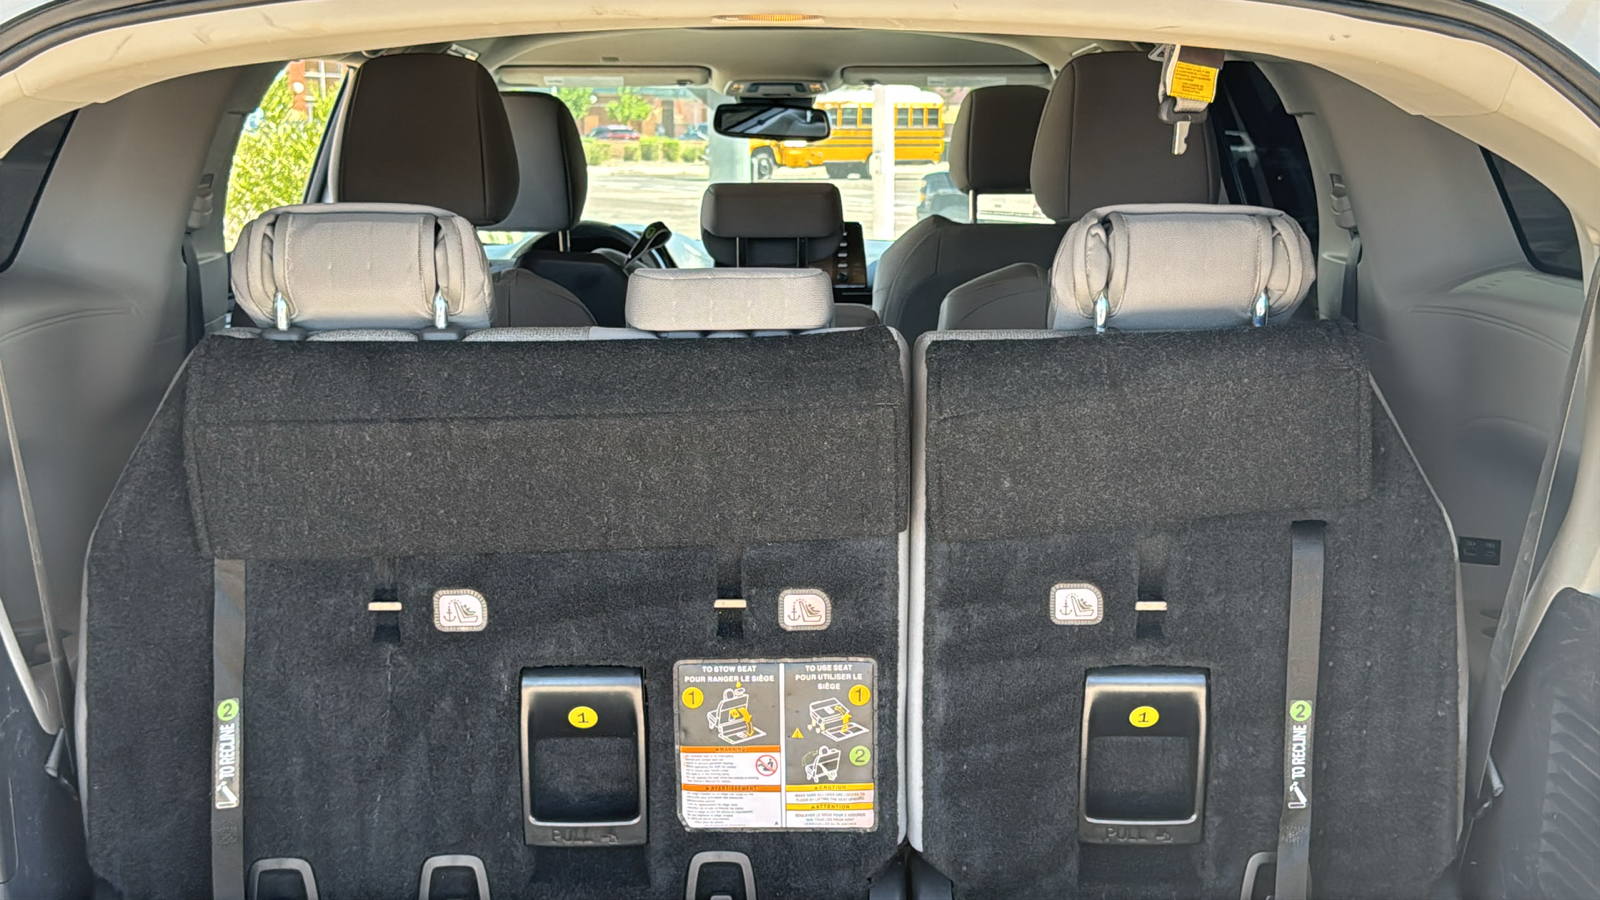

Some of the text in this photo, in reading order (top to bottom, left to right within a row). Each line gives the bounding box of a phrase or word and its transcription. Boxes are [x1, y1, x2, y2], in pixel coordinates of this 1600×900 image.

[751, 674, 775, 682] SIÈGE
[688, 690, 695, 705] 1
[856, 688, 862, 703] 1
[223, 702, 233, 718] 2
[1137, 712, 1150, 723] 1
[1296, 704, 1306, 718] 2
[577, 712, 590, 724] 1
[219, 722, 236, 780] TO RECLINE
[854, 748, 866, 763] 2
[1292, 724, 1308, 780] TO RECLINE
[552, 829, 594, 844] PULL
[1106, 827, 1148, 842] PULL
